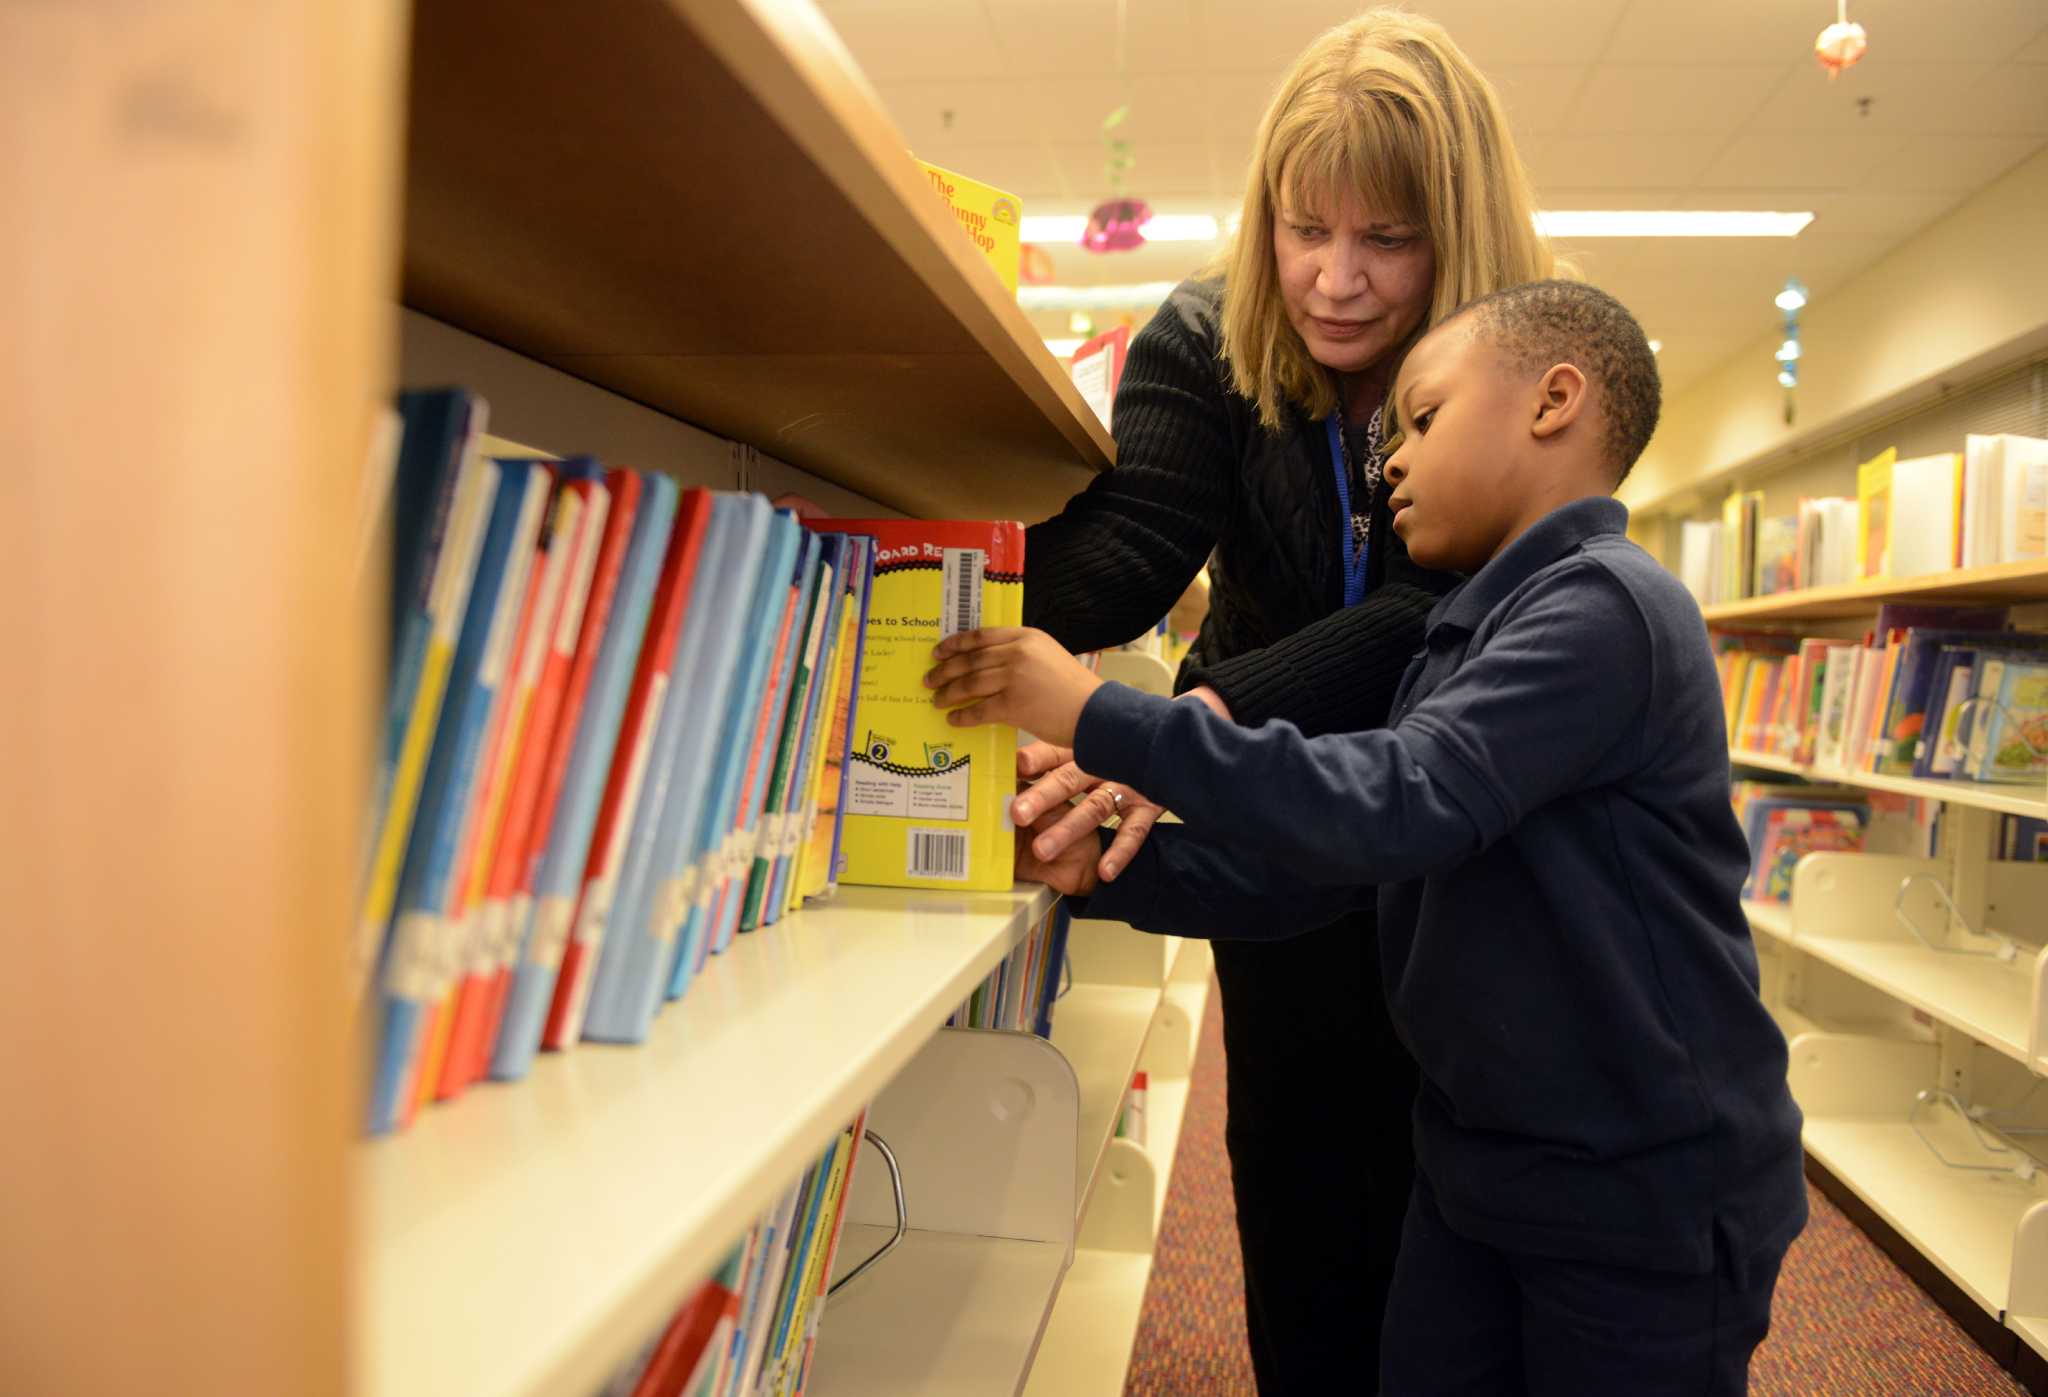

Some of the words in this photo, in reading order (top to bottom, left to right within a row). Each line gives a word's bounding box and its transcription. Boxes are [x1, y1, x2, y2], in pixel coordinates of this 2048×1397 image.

[928, 170, 954, 198] The
[943, 196, 987, 230] unny
[886, 617, 898, 626] to
[901, 616, 940, 628] School
